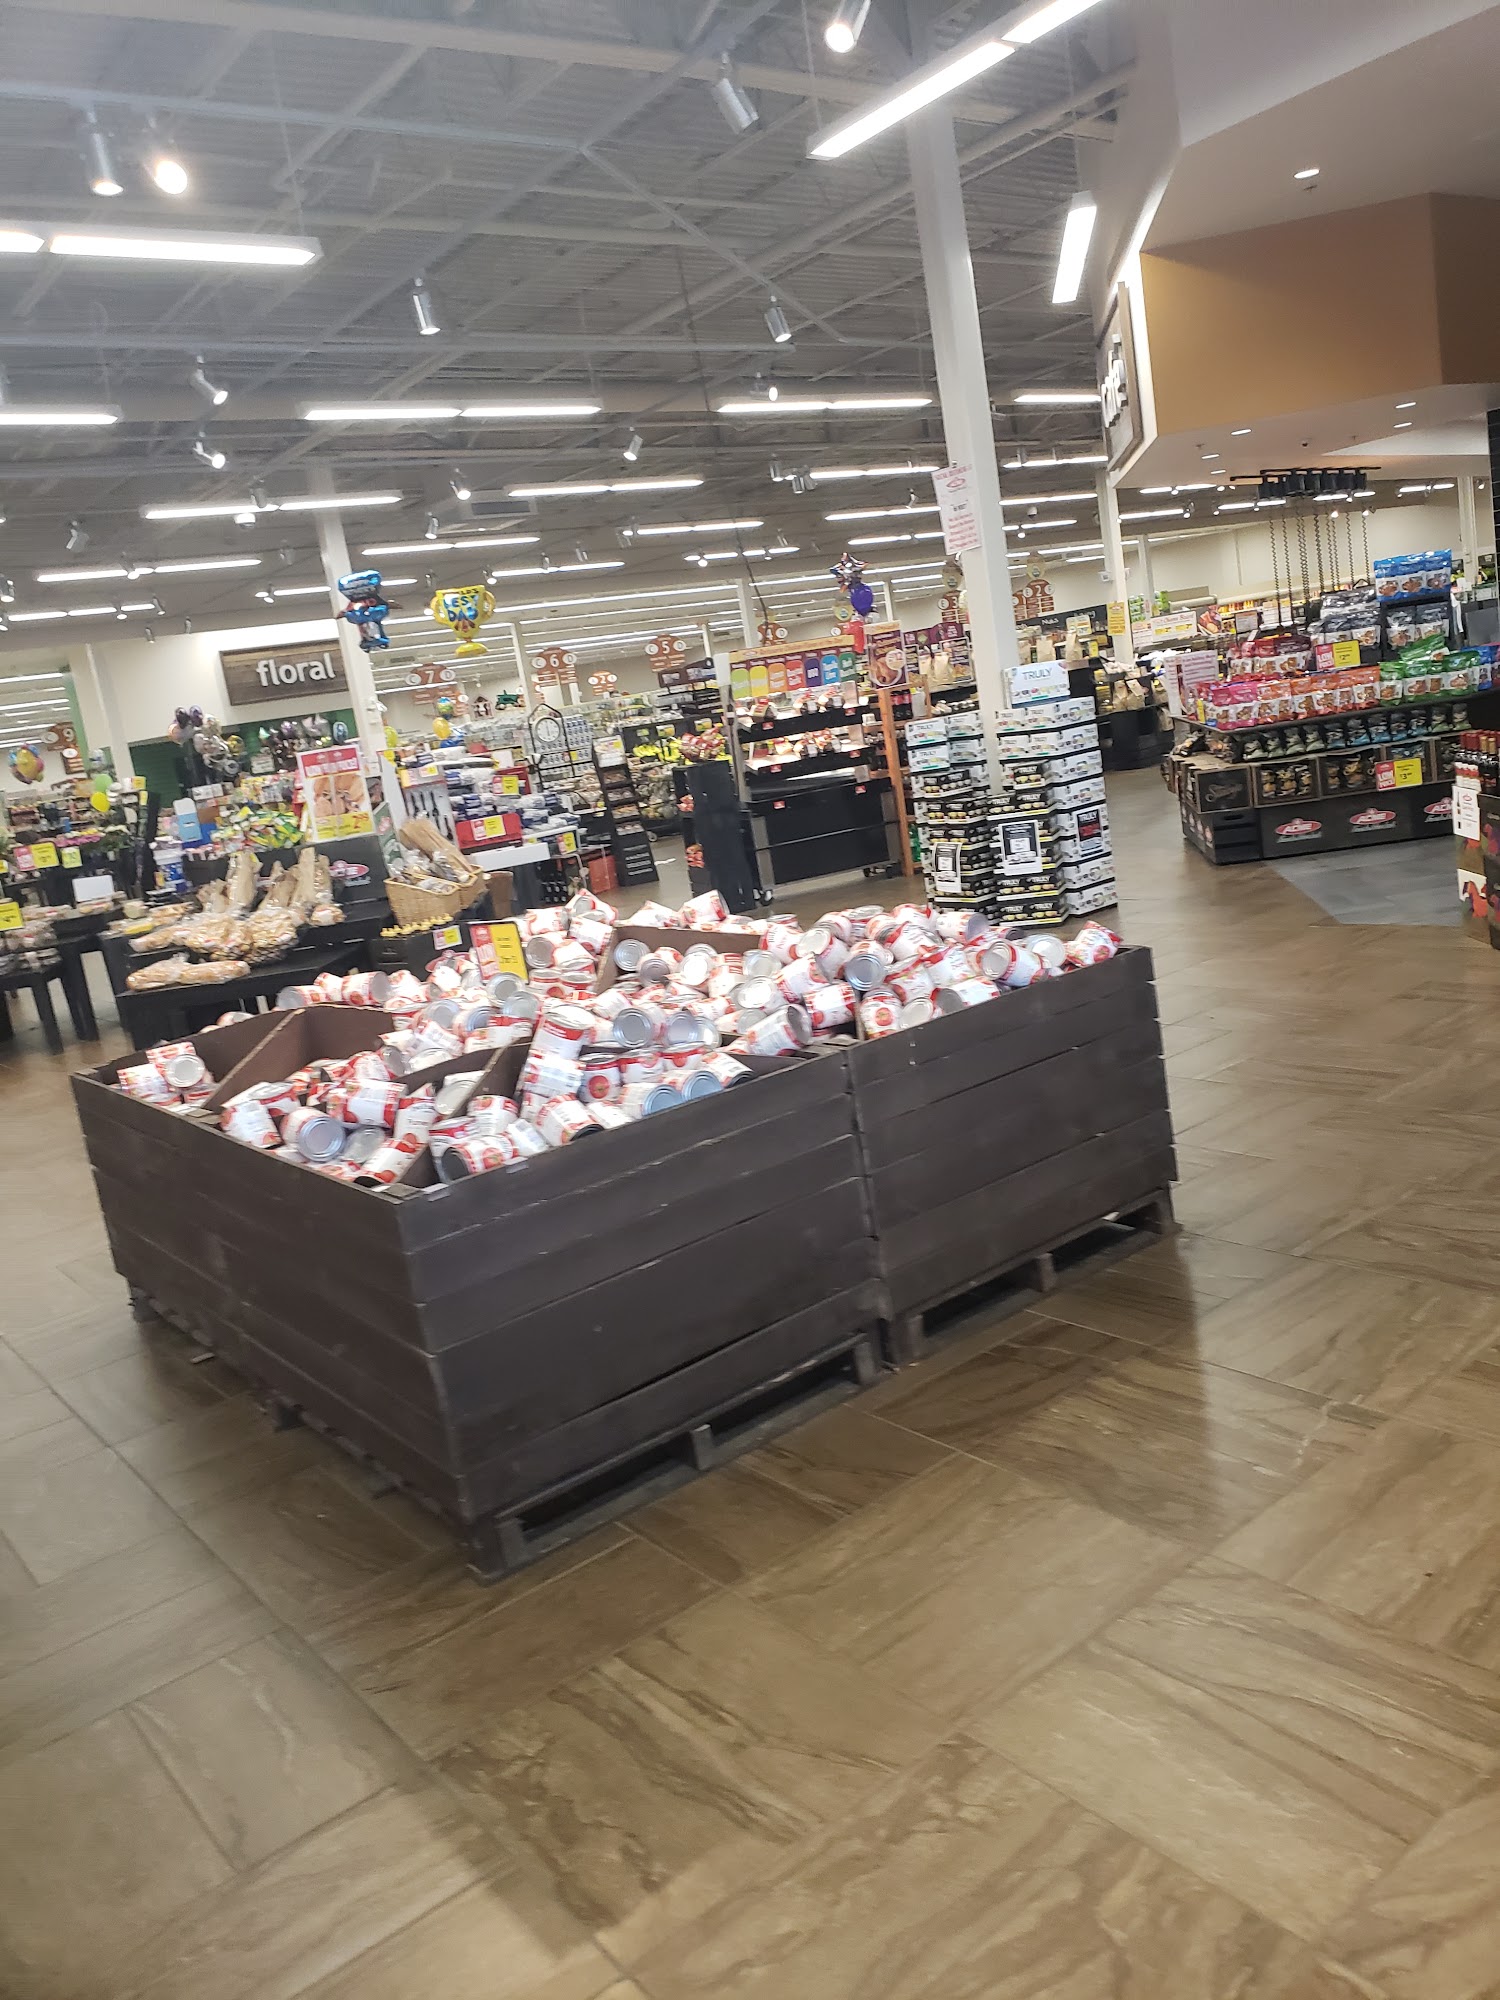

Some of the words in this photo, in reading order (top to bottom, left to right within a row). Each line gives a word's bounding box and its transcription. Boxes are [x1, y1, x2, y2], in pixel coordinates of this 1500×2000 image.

[1035, 584, 1042, 597] 2
[951, 596, 958, 609] 3
[661, 640, 670, 654] 5
[549, 653, 560, 668] 6
[256, 652, 337, 687] floral
[1022, 667, 1053, 681] TRULY
[424, 670, 435, 684] 7
[62, 728, 75, 742] 9
[1357, 812, 1387, 824] ACME
[1282, 823, 1313, 835] ACME
